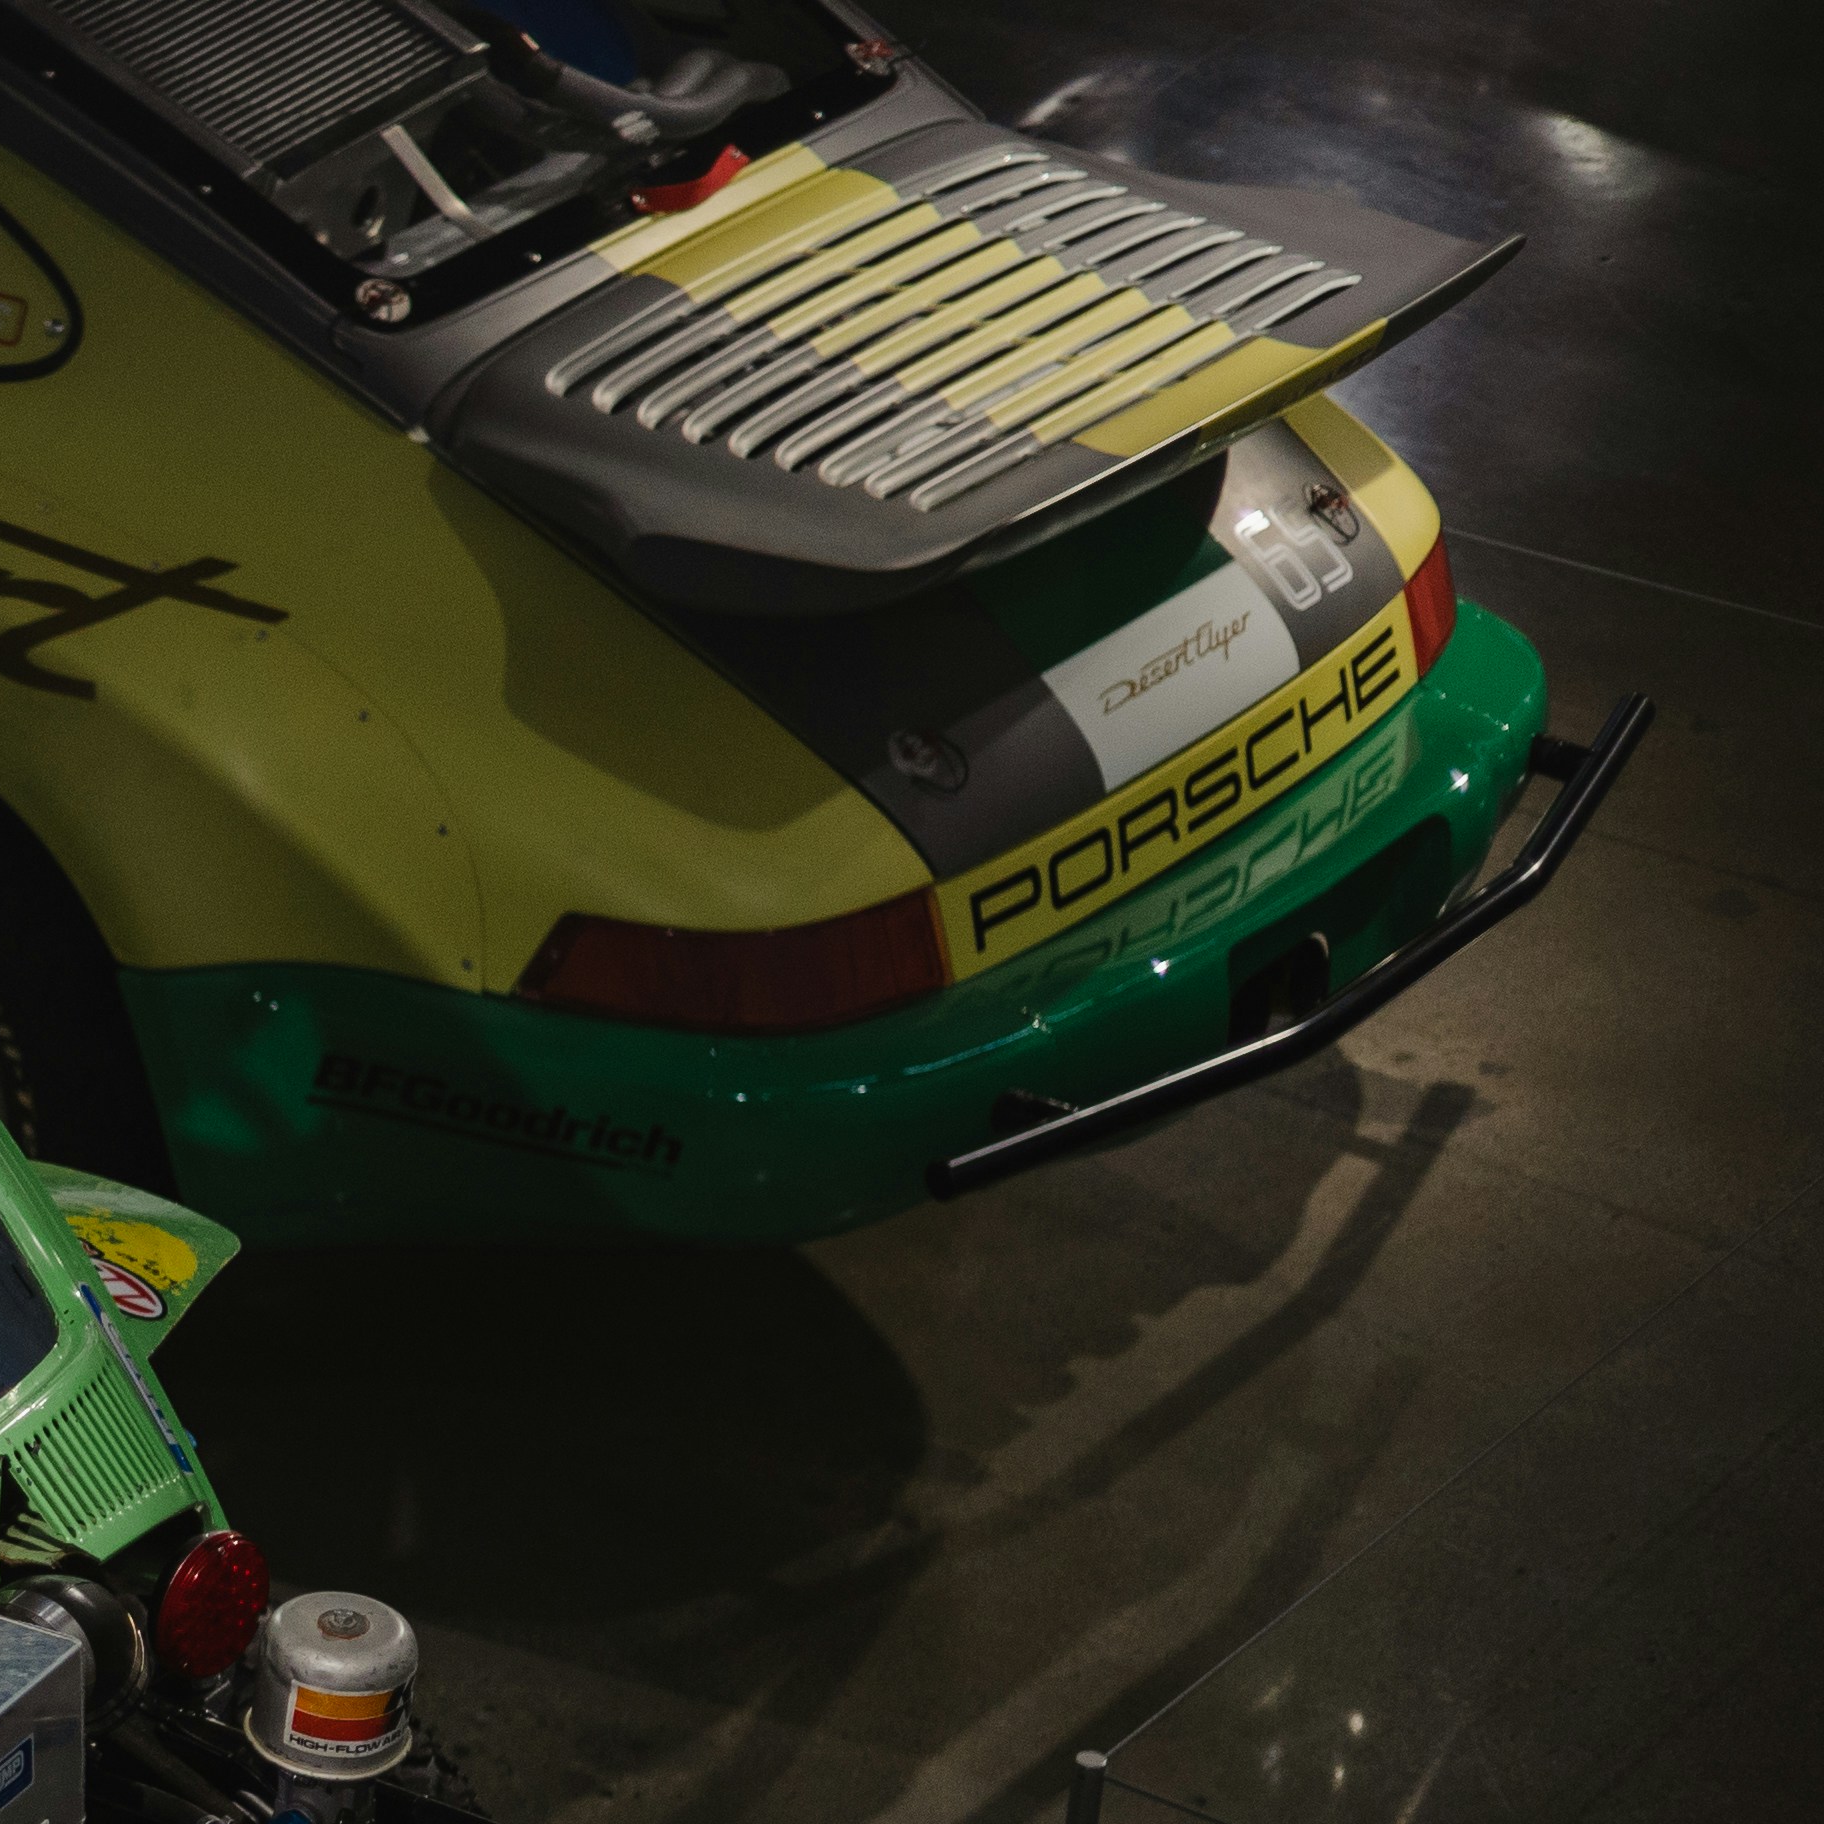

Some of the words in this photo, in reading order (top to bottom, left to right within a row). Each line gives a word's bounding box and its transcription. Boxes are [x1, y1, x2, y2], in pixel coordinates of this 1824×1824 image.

[971, 625, 1401, 953] PORSCHE
[314, 1054, 683, 1166] BFGoodrich
[289, 1732, 381, 1754] HIGH-FLOW
